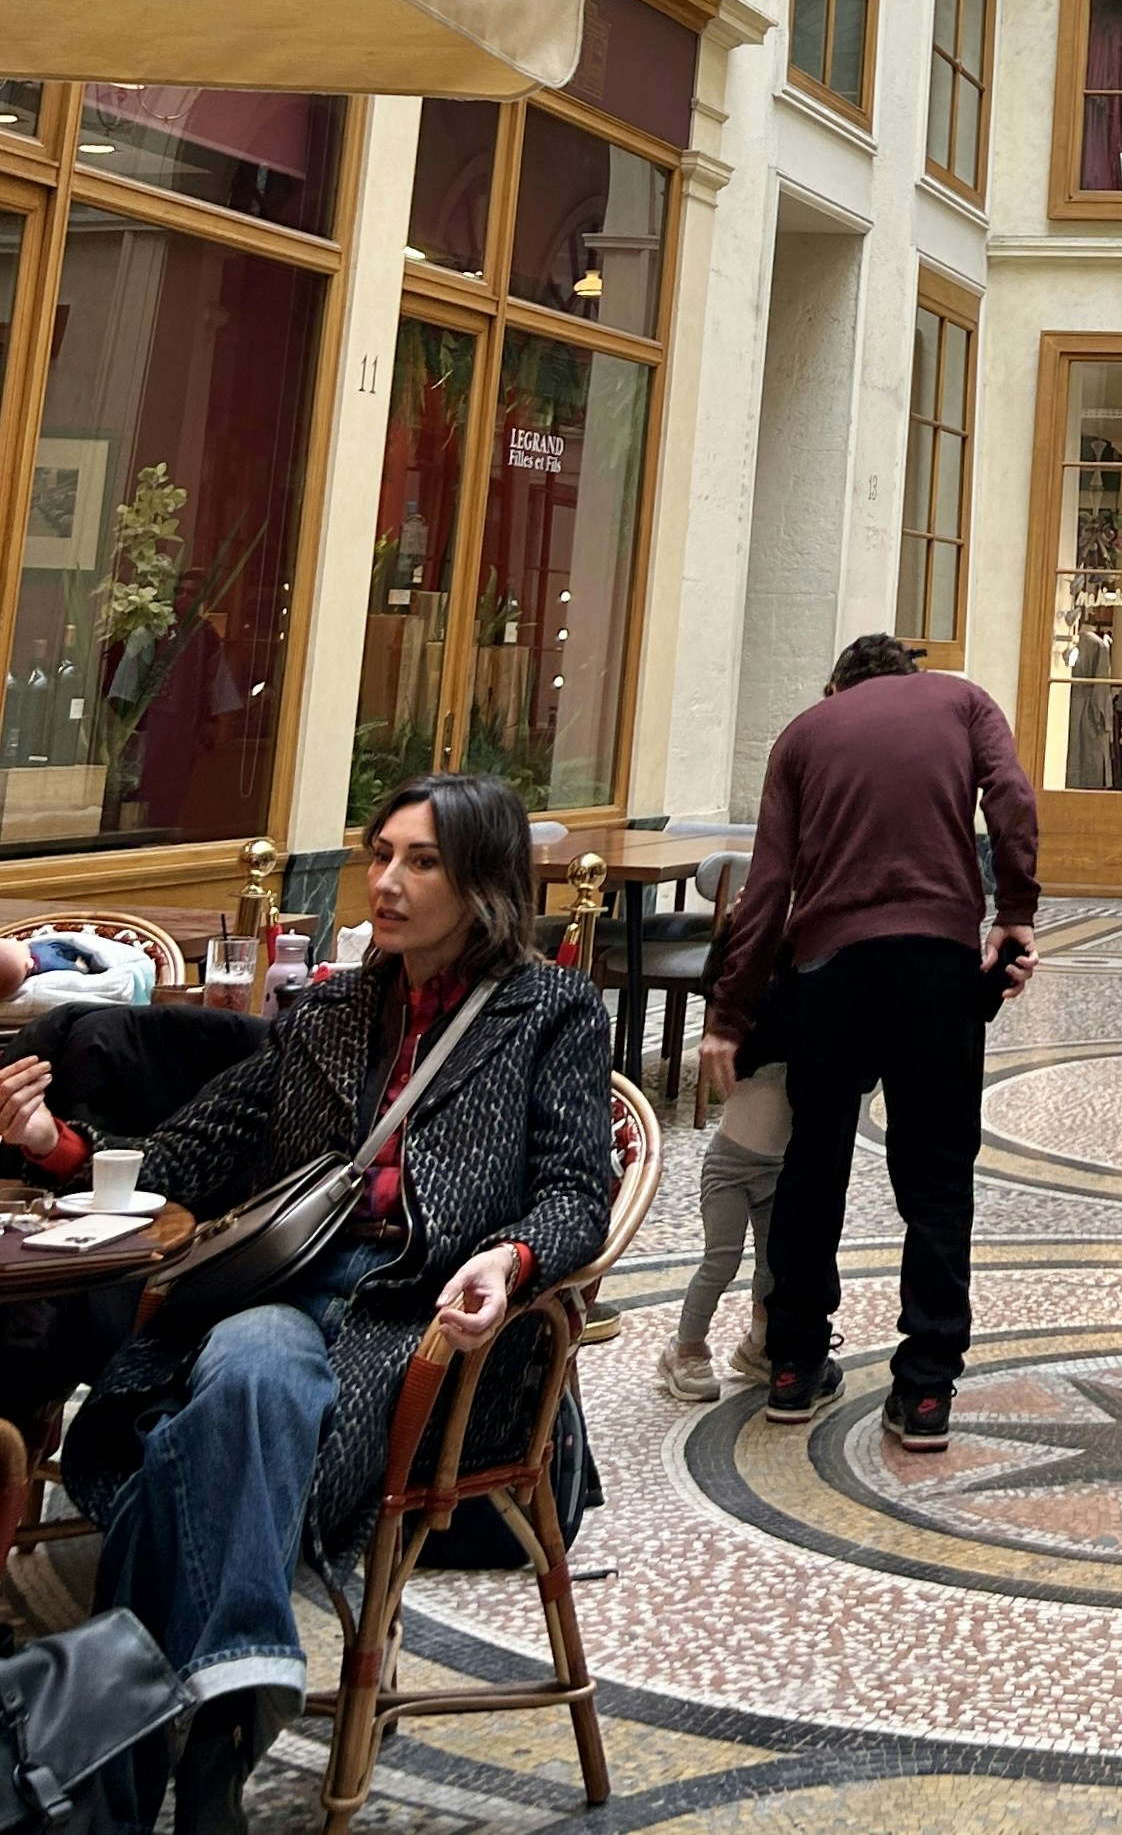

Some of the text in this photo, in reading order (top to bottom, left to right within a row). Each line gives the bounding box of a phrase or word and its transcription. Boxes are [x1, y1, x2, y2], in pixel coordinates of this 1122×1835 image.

[358, 353, 378, 394] 11
[509, 428, 564, 456] LEGRAND
[508, 449, 562, 474] Filles et Fils
[868, 474, 878, 501] 13
